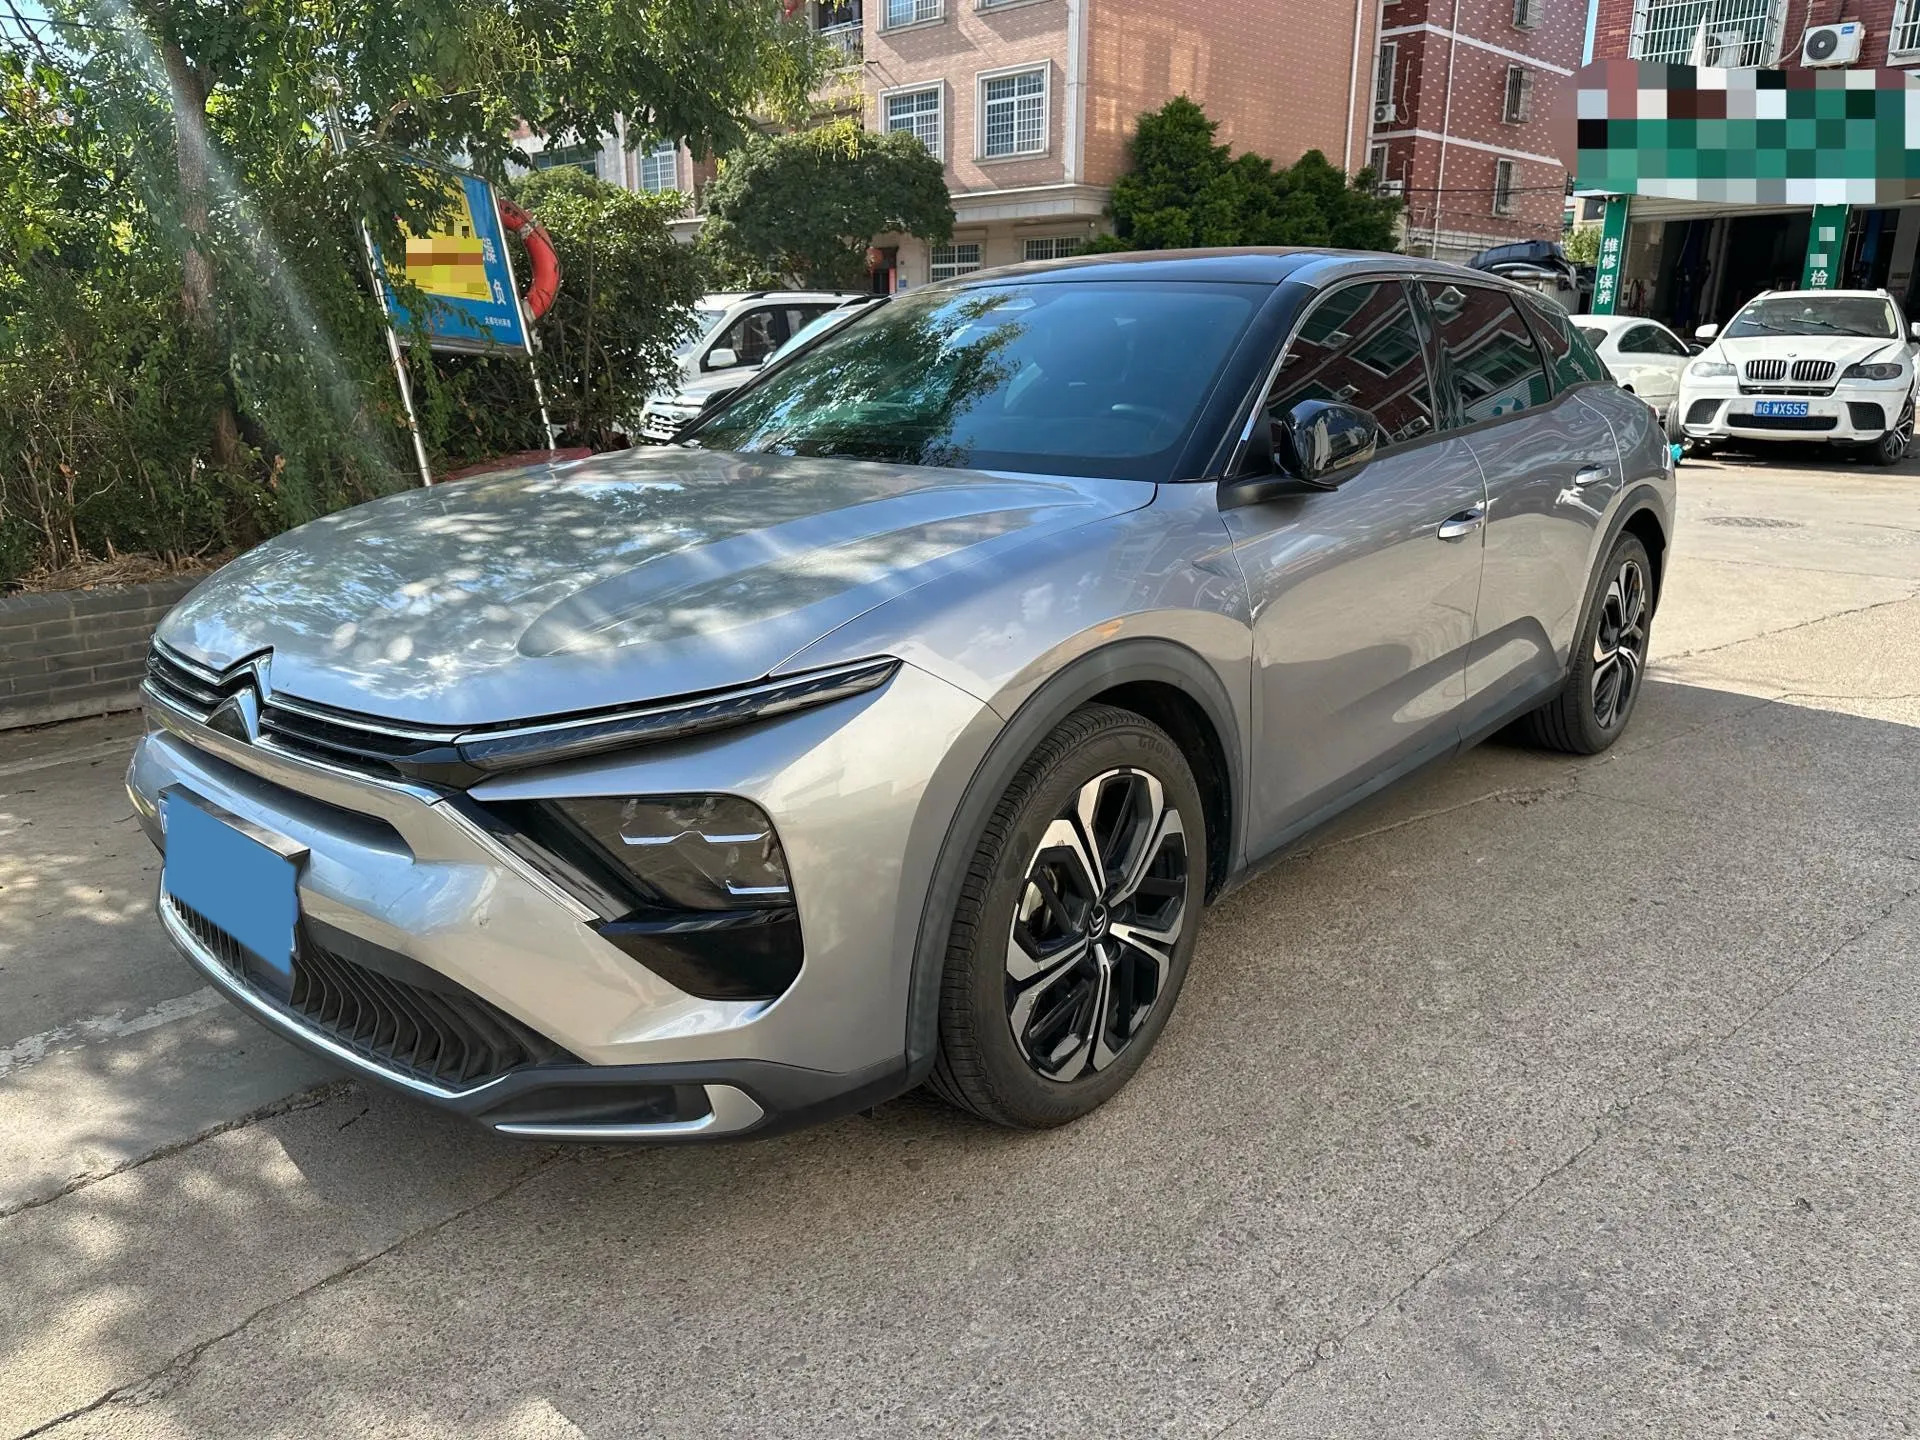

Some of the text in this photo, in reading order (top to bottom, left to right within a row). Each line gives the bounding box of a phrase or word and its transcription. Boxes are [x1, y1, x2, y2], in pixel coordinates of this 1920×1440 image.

[1597, 237, 1619, 305] 维修保养
[1810, 269, 1828, 291] 检
